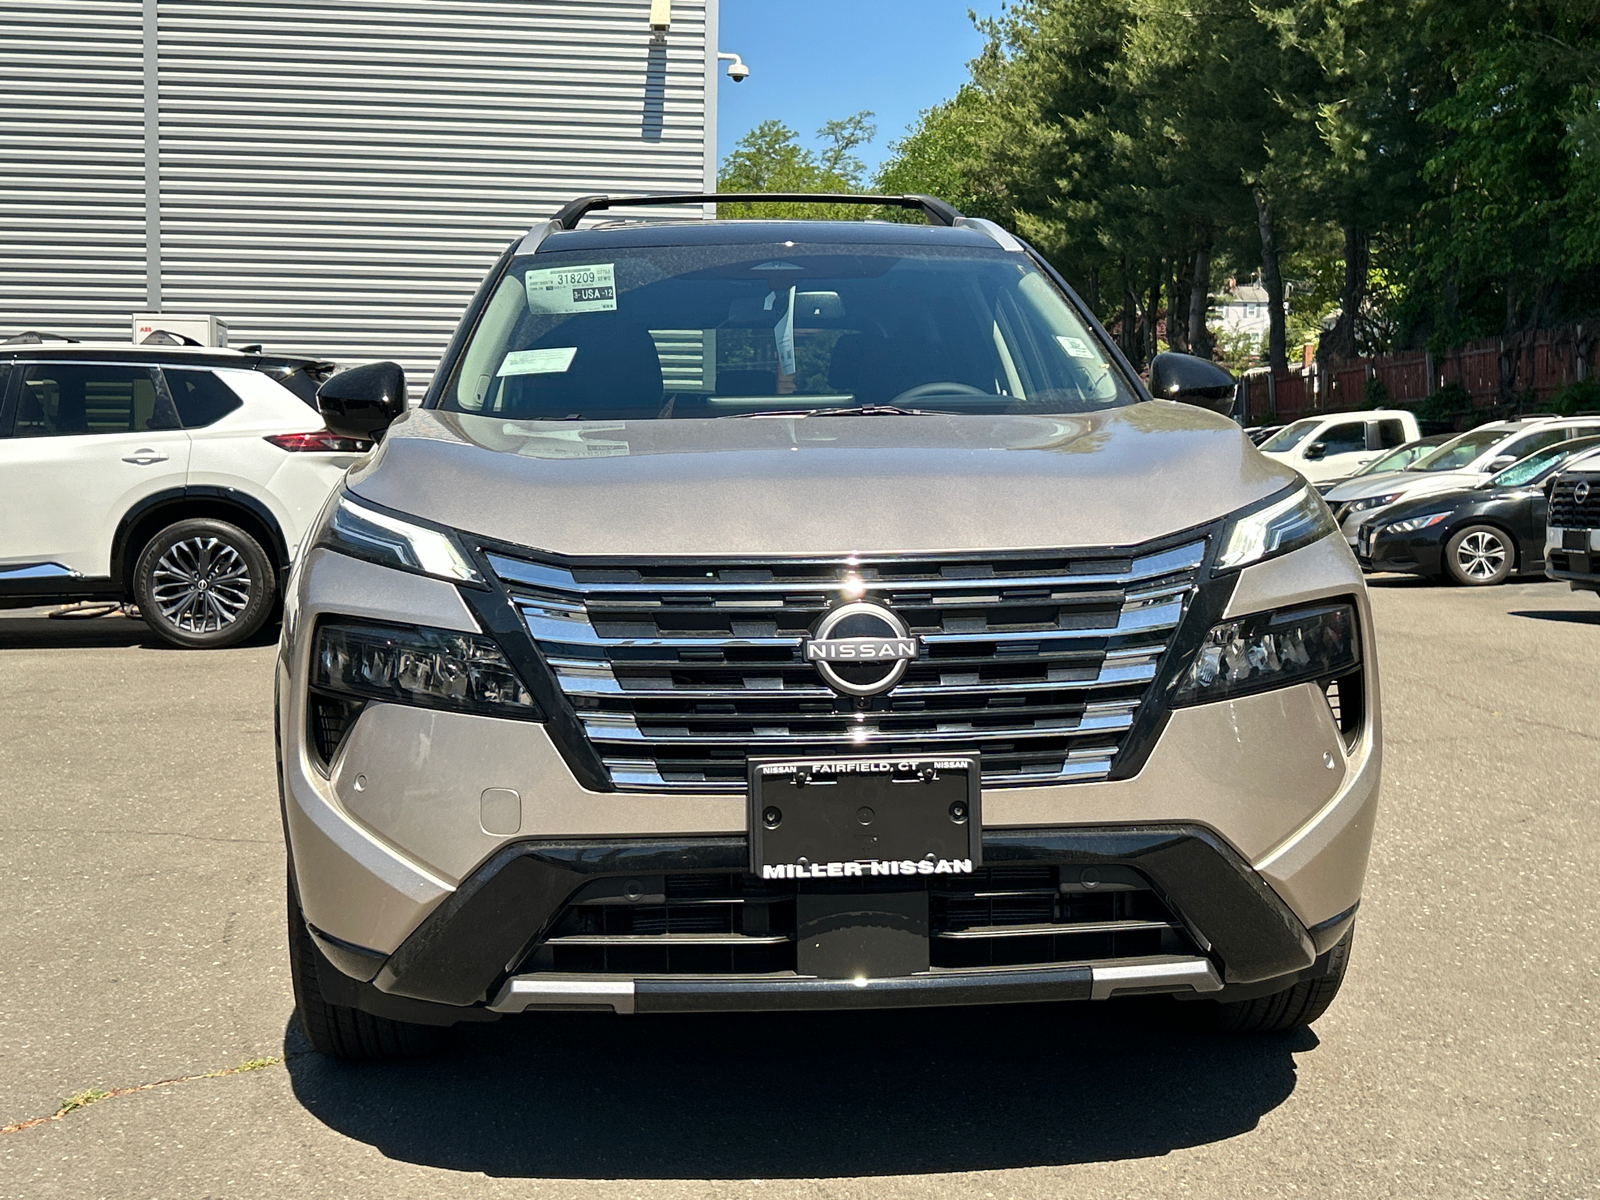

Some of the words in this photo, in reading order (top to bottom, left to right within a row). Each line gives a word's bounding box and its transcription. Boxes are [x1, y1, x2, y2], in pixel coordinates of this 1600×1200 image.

[557, 272, 595, 285] 318209
[581, 288, 601, 300] USA
[809, 642, 915, 658] NISSAN
[762, 766, 797, 774] NISSAN
[812, 762, 894, 773] FAIRFIELD,
[897, 762, 919, 771] CT
[933, 761, 969, 769] NISSAN
[762, 862, 865, 880] MILLER
[870, 858, 973, 876] NISSAN
